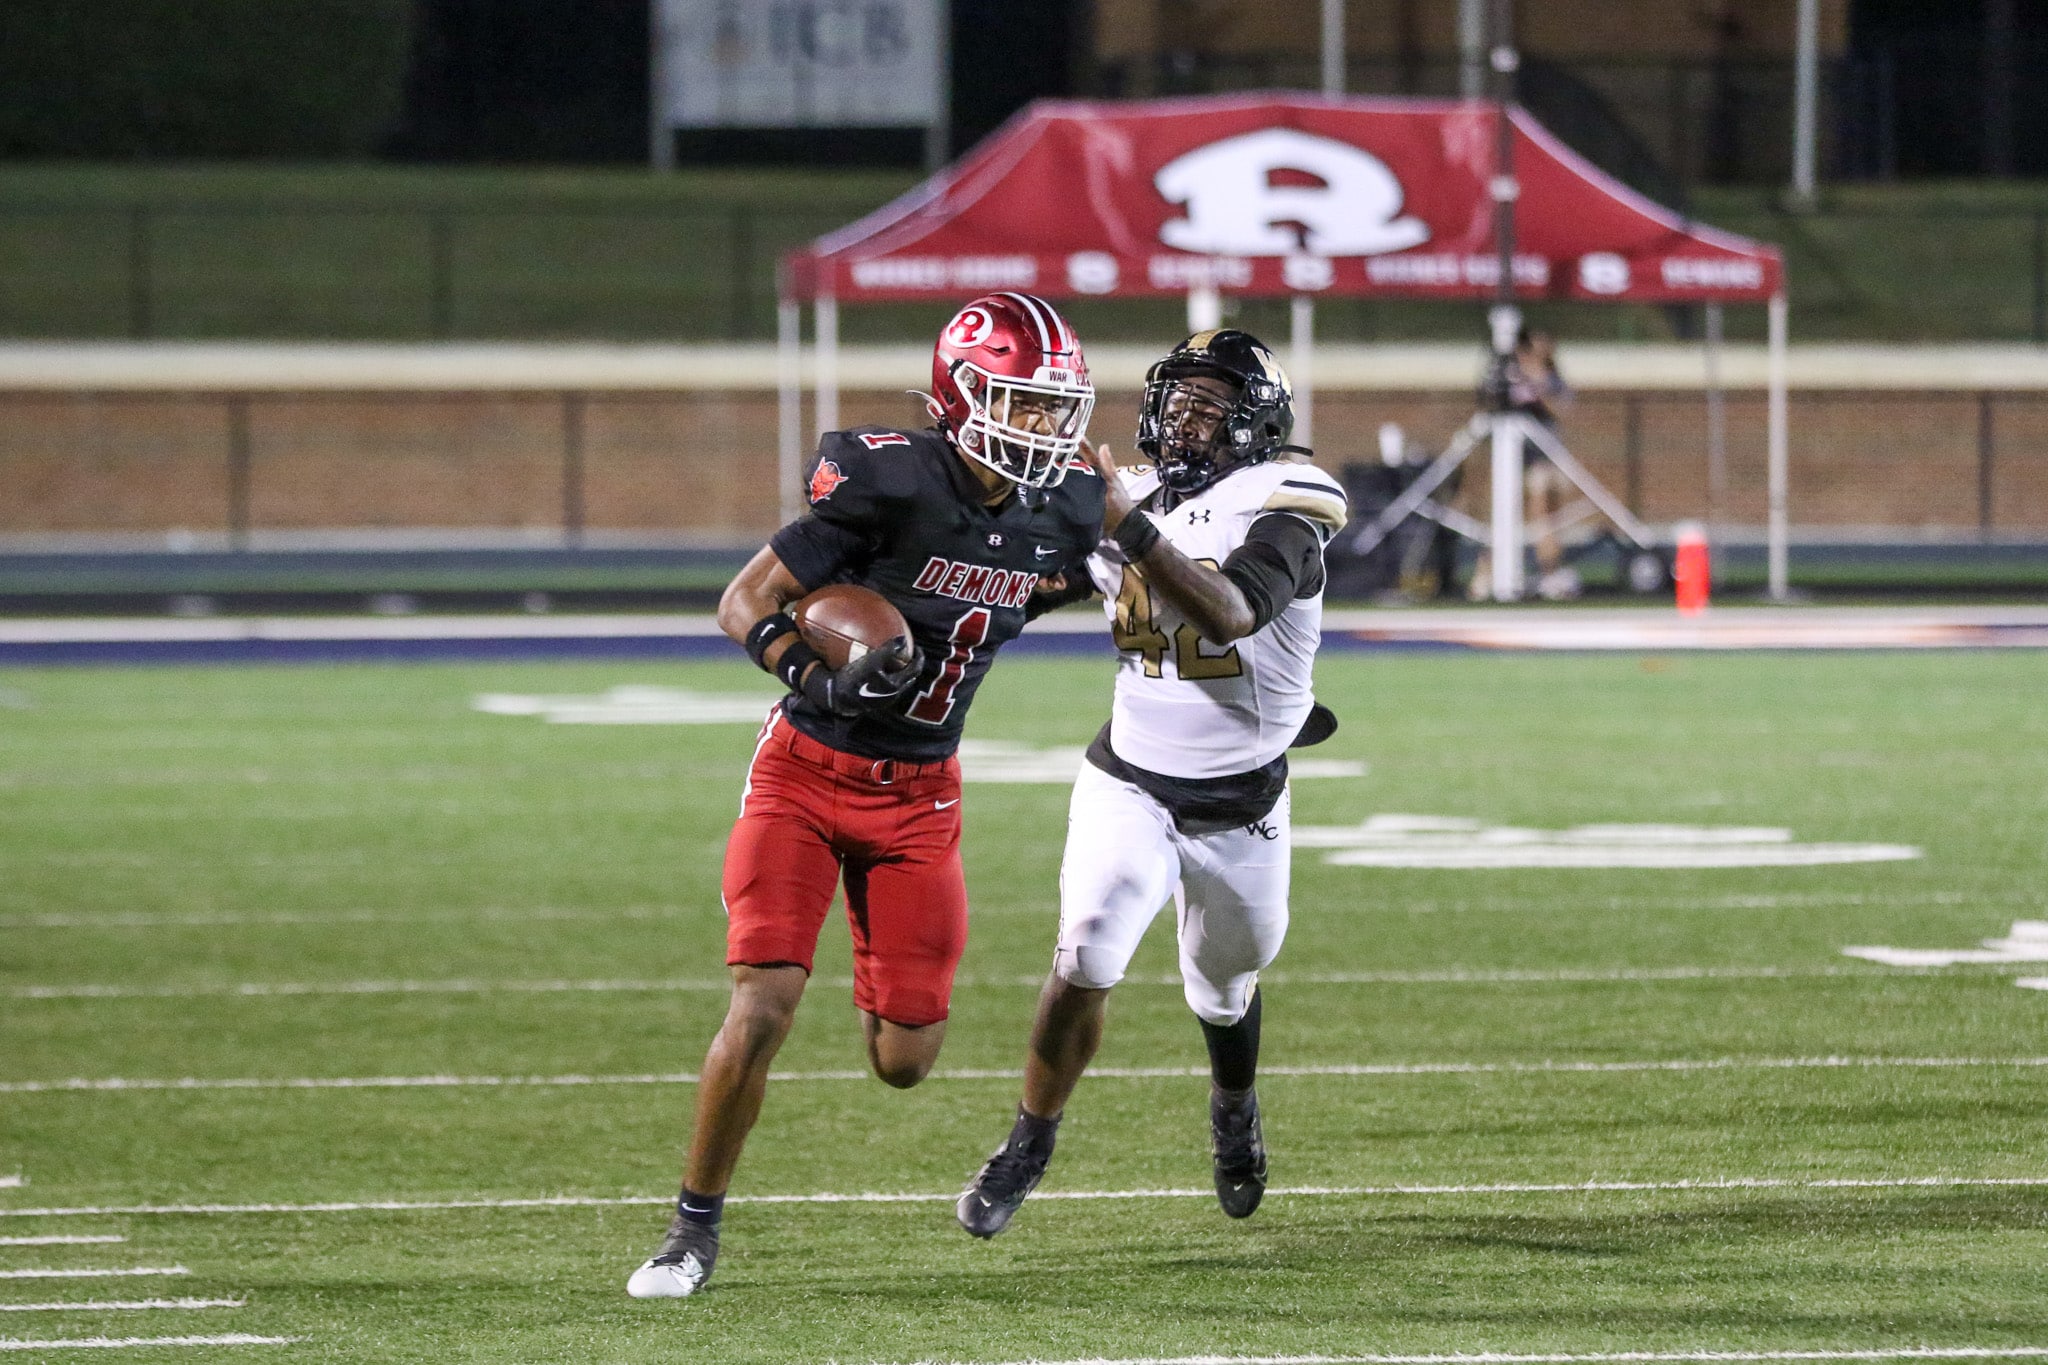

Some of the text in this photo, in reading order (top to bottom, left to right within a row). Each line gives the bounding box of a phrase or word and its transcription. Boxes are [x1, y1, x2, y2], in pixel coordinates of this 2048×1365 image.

[1154, 127, 1430, 256] R
[948, 309, 986, 343] R
[1049, 371, 1067, 382] WAR
[859, 432, 911, 449] 1
[987, 533, 1002, 546] R
[912, 556, 1039, 608] DEMONS
[1113, 558, 1243, 681] 42
[905, 606, 991, 725] 1
[1246, 821, 1279, 840] WC
